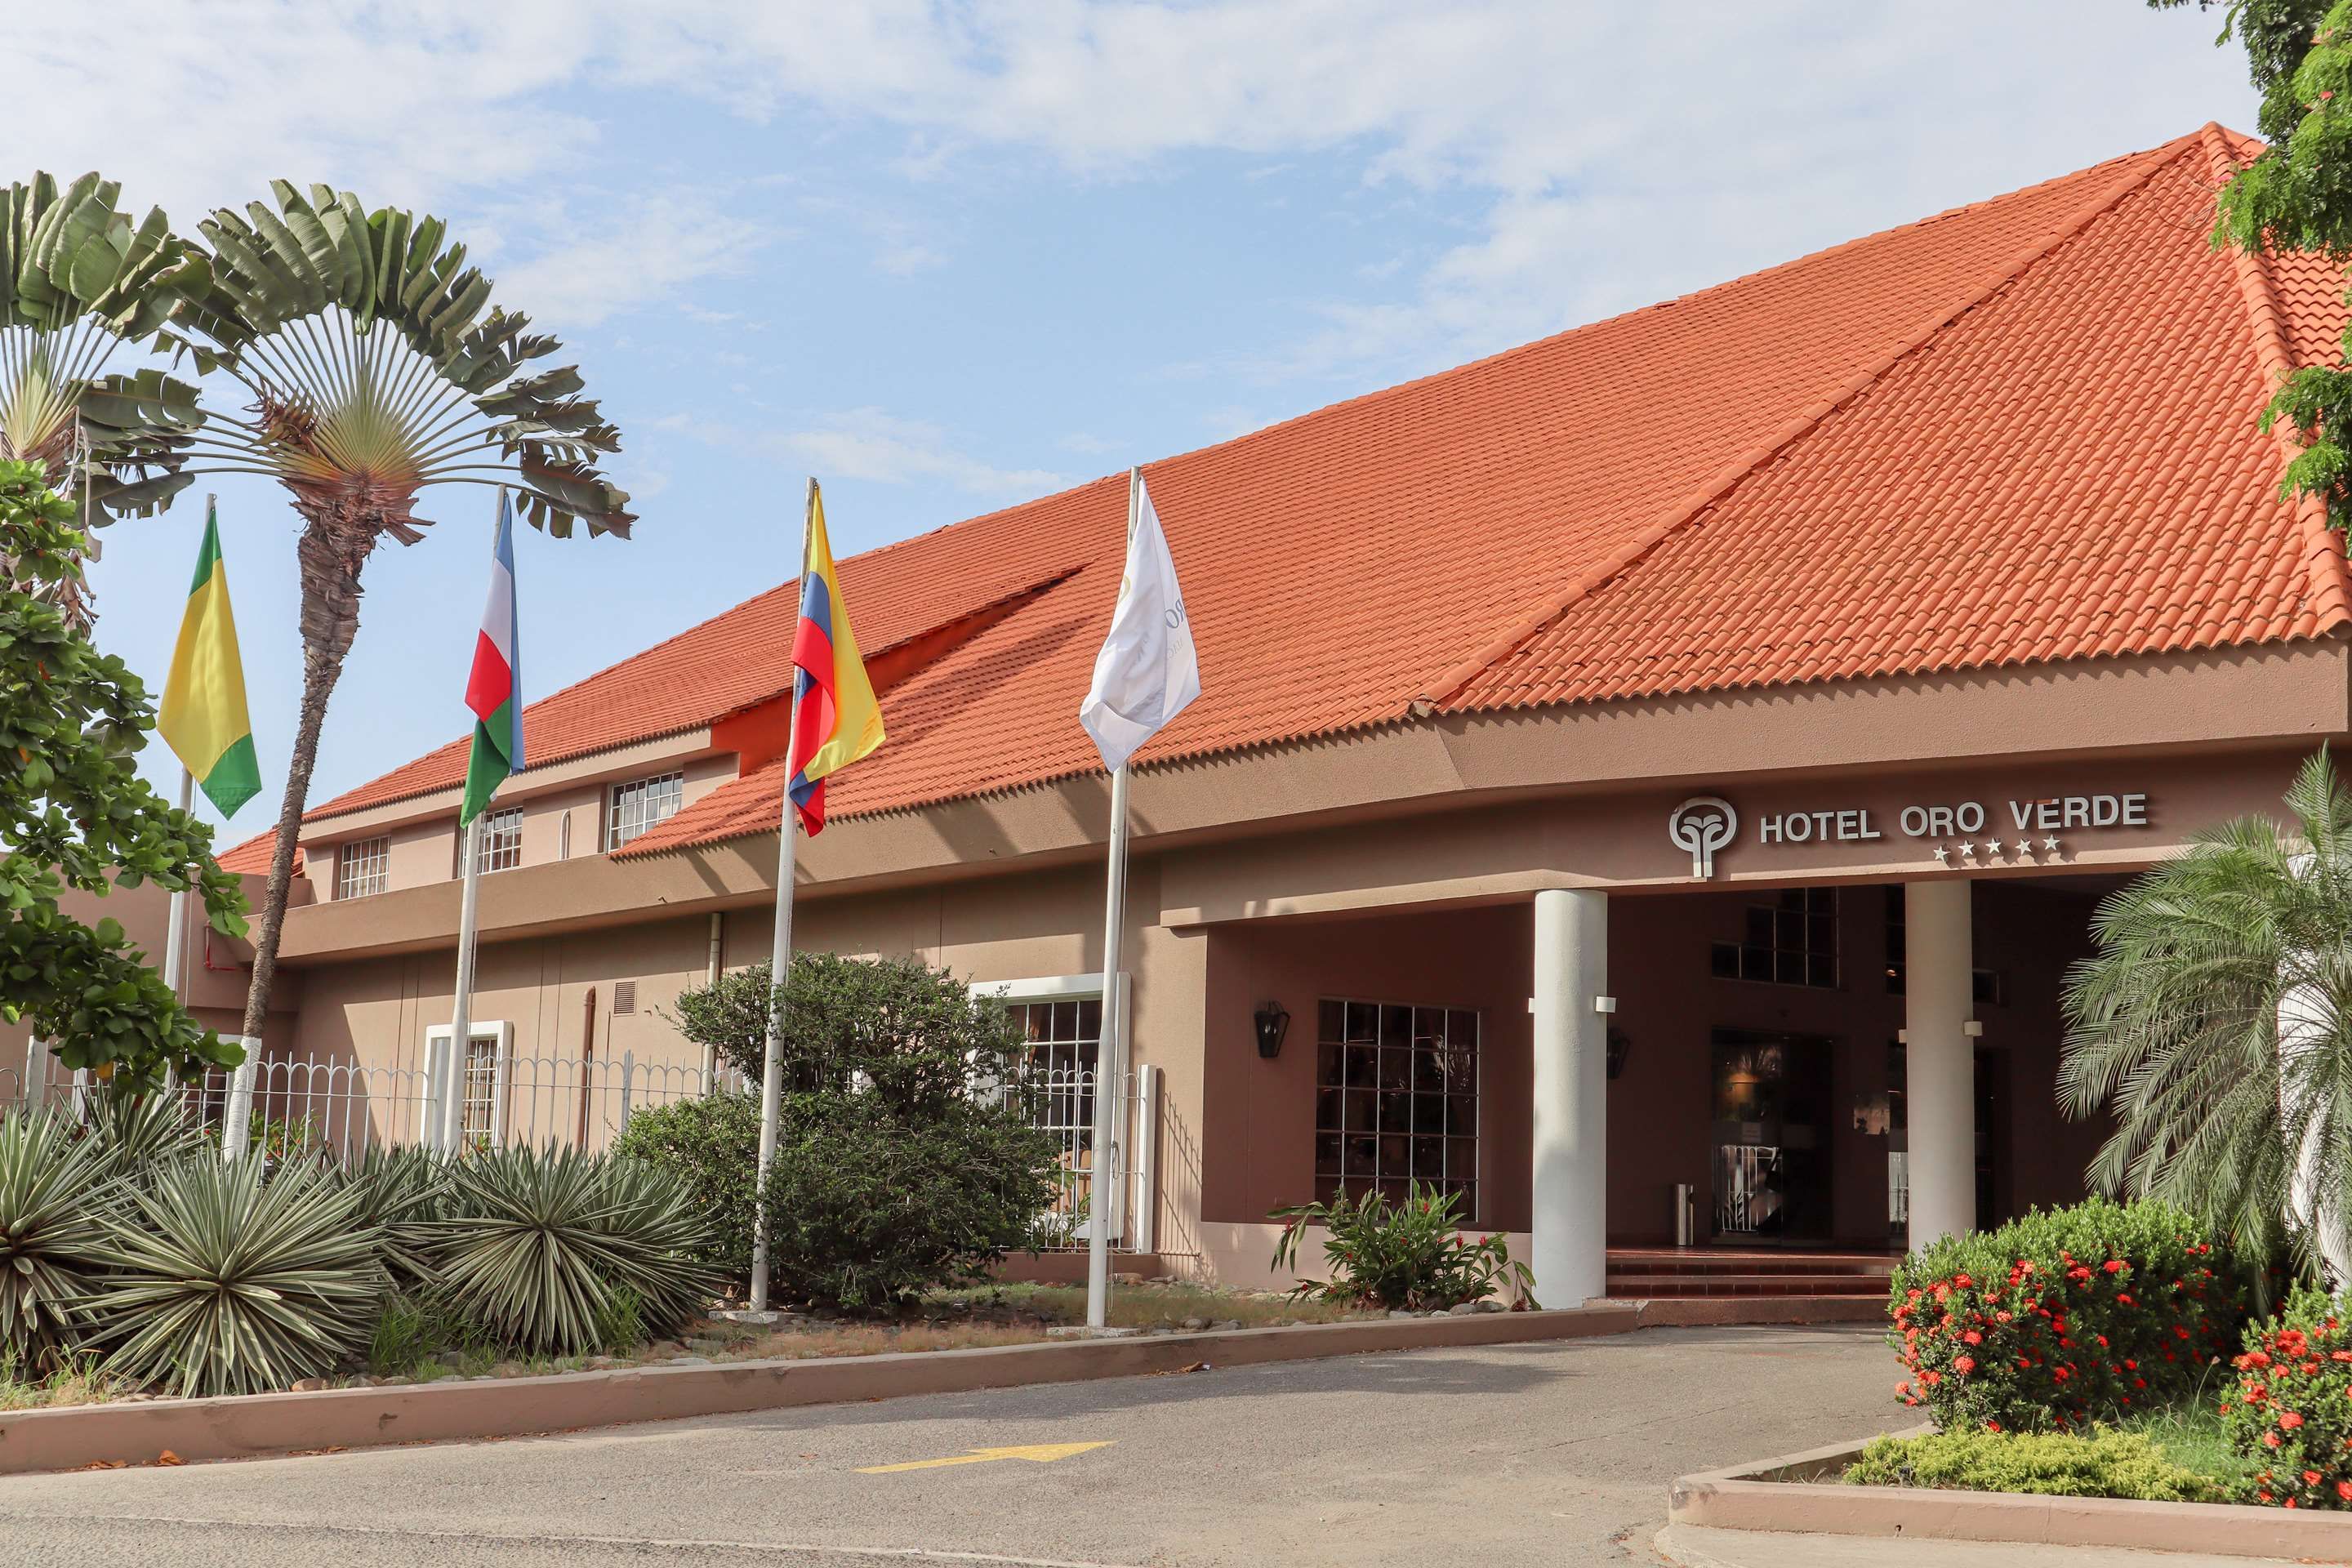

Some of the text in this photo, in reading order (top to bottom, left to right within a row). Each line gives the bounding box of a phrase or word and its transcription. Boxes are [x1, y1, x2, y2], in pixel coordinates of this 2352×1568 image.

[1759, 794, 2148, 844] HOTEL ORO VERDE
